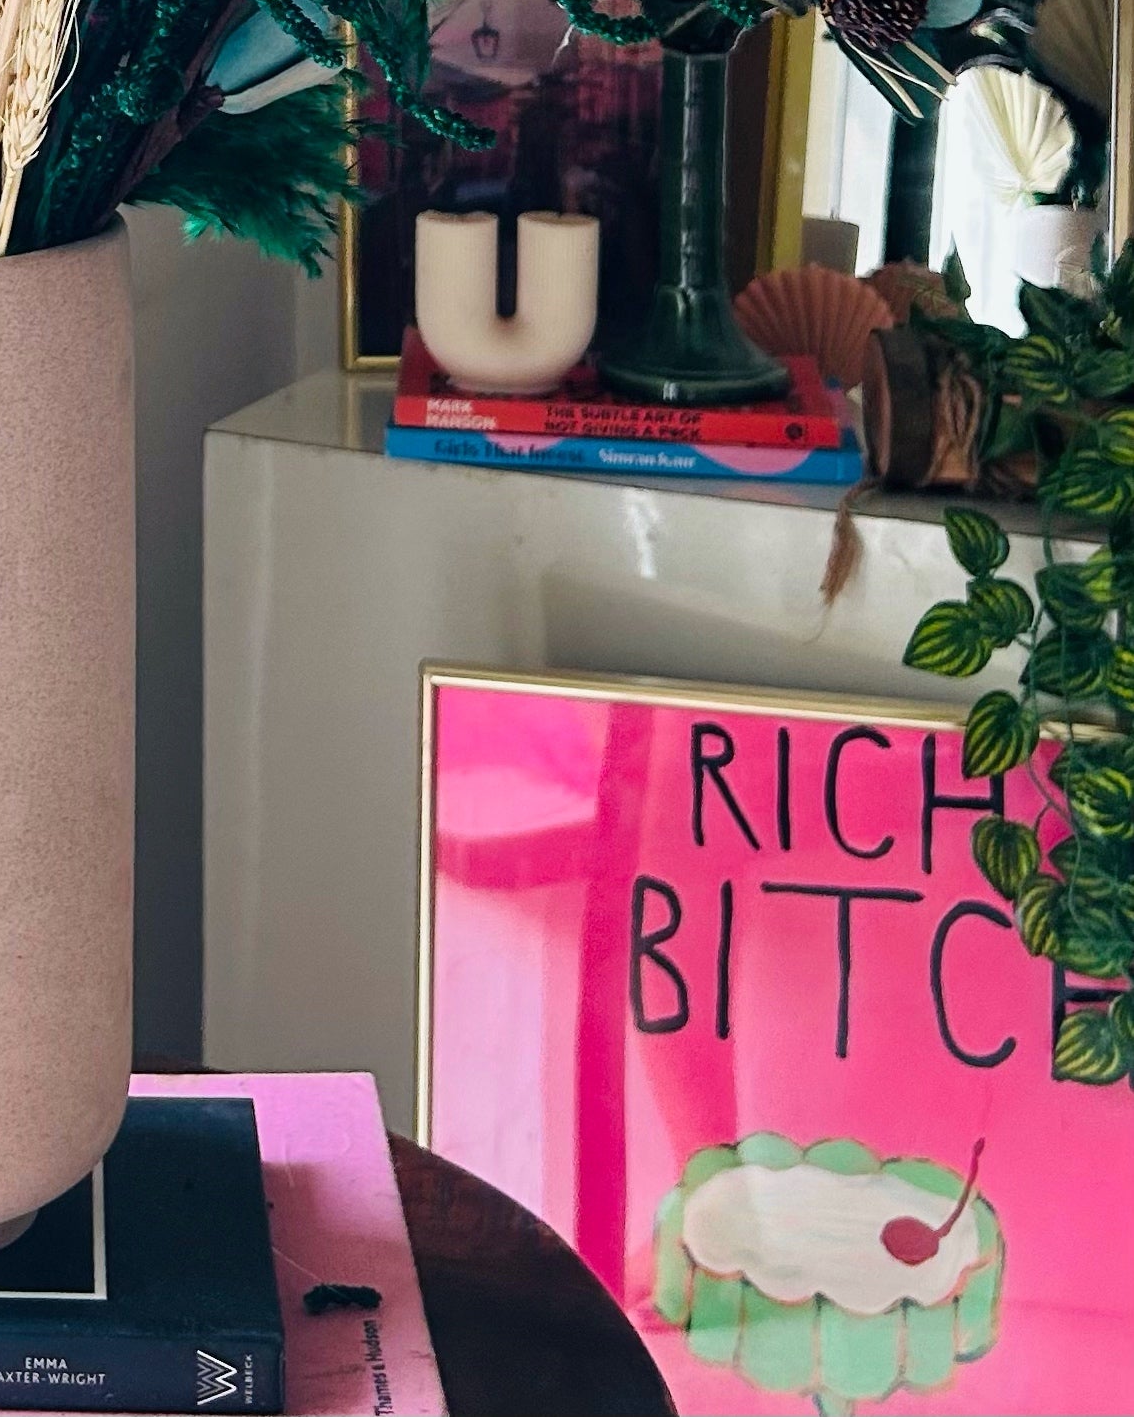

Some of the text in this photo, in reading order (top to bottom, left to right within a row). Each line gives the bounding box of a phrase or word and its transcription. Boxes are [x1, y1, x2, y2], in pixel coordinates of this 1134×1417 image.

[546, 404, 702, 424] THE SUBTLE ART OF
[689, 723, 1004, 874] RICH
[363, 1320, 385, 1362] Hudson
[25, 1357, 68, 1370] EMMA
[244, 1354, 253, 1404] WELBECK
[372, 1372, 395, 1416] Thames
